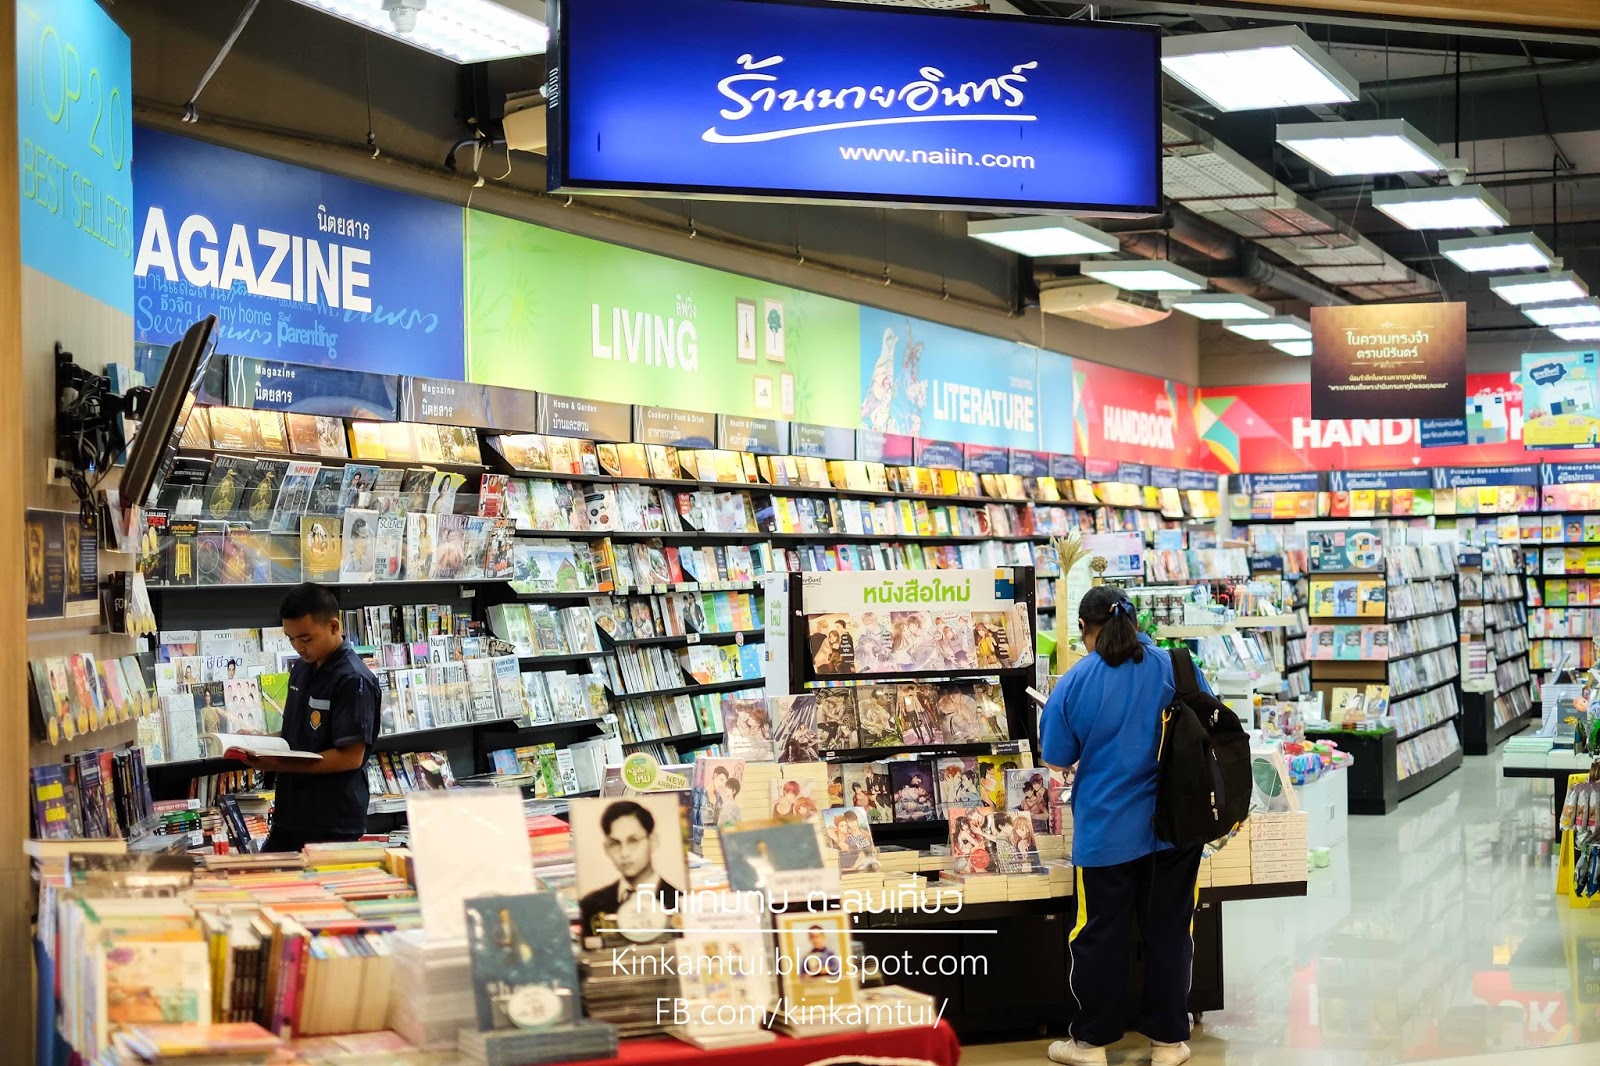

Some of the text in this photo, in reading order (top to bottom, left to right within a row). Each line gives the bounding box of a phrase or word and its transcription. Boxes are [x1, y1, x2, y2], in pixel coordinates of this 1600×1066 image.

[19, 4, 125, 171] TOP 20
[717, 53, 1038, 121] ร้านนายอินทร์
[838, 143, 1036, 171] www.naiin.com
[22, 137, 133, 258] BEST SELLERS
[316, 203, 370, 240] นิตยสาร
[134, 206, 372, 313] AGAZINE
[160, 294, 192, 315] ชีวจิต
[219, 302, 272, 327] my home
[277, 320, 339, 360] parenting
[589, 302, 699, 373] LIVING
[1346, 330, 1429, 346] ในความทรงจำ
[1356, 346, 1418, 359] ตราบนิรันดร์
[254, 364, 296, 379] Magazine
[254, 382, 293, 404] นิตยสาร
[421, 382, 456, 396] Magazine
[421, 401, 453, 418] นิตยสาร
[553, 399, 570, 410] Home
[576, 402, 597, 413] Garden
[932, 379, 1035, 433] LITERATURE
[552, 412, 590, 432] บ้านและสวน
[1103, 404, 1175, 449] HANDBOOK
[863, 577, 971, 604] หนังสือใหม่
[666, 775, 686, 787] NEW
